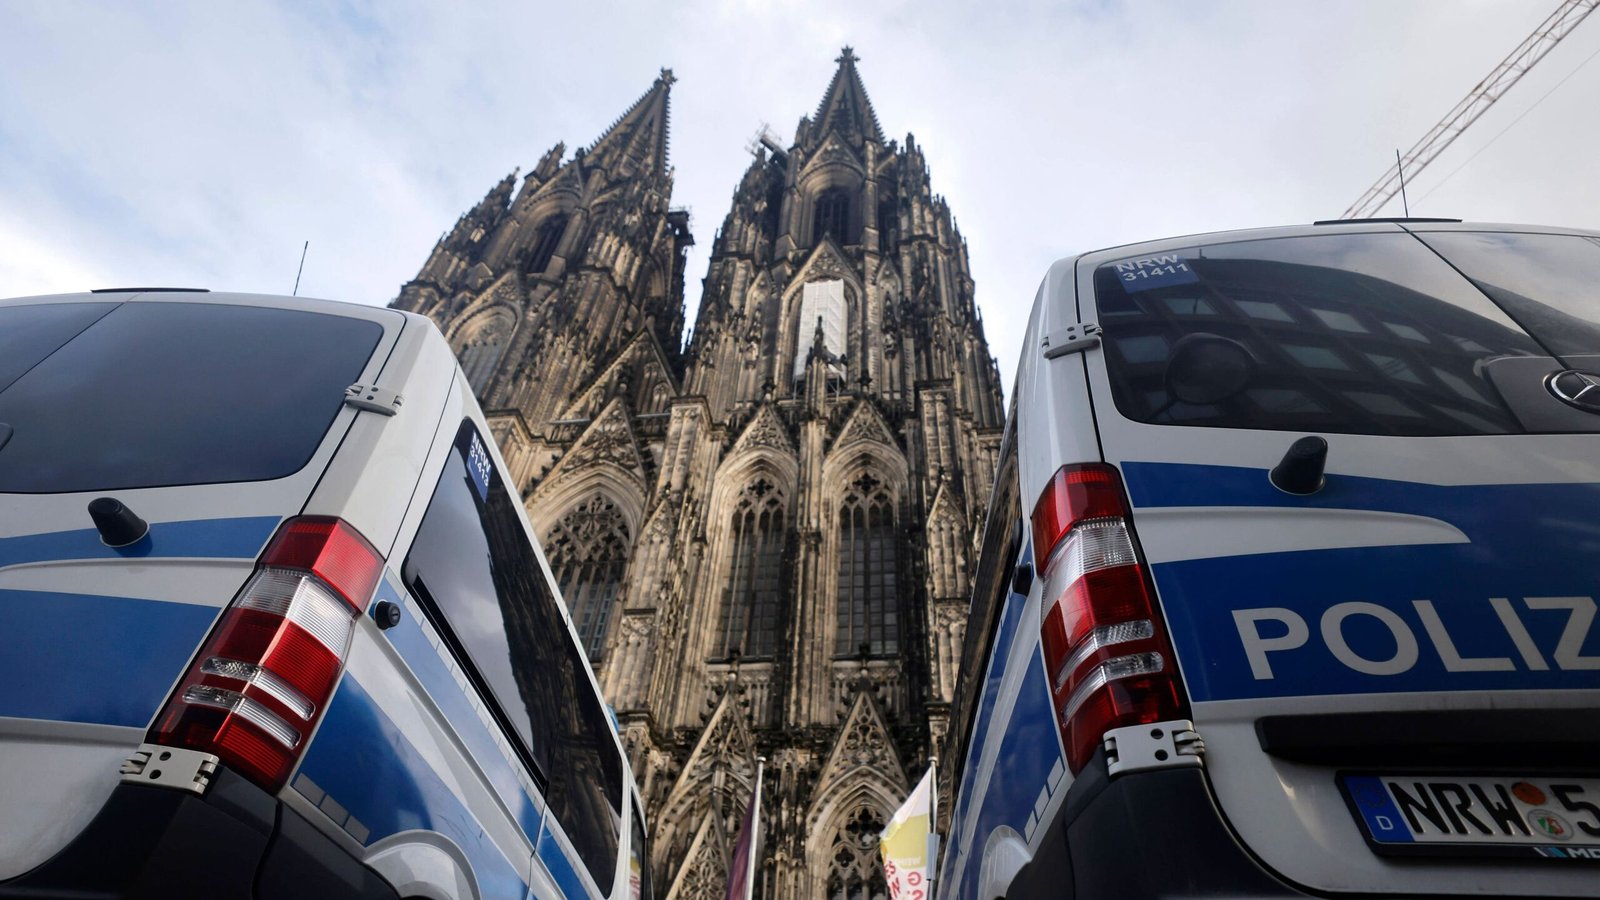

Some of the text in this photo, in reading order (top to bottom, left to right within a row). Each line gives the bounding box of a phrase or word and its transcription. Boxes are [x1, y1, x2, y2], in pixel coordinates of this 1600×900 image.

[1116, 254, 1178, 272] NRW
[1122, 263, 1189, 281] 31411
[472, 431, 491, 473] NRW
[1231, 596, 1600, 680] POLIZ
[1376, 815, 1394, 831] D
[1387, 782, 1600, 837] NRW 5
